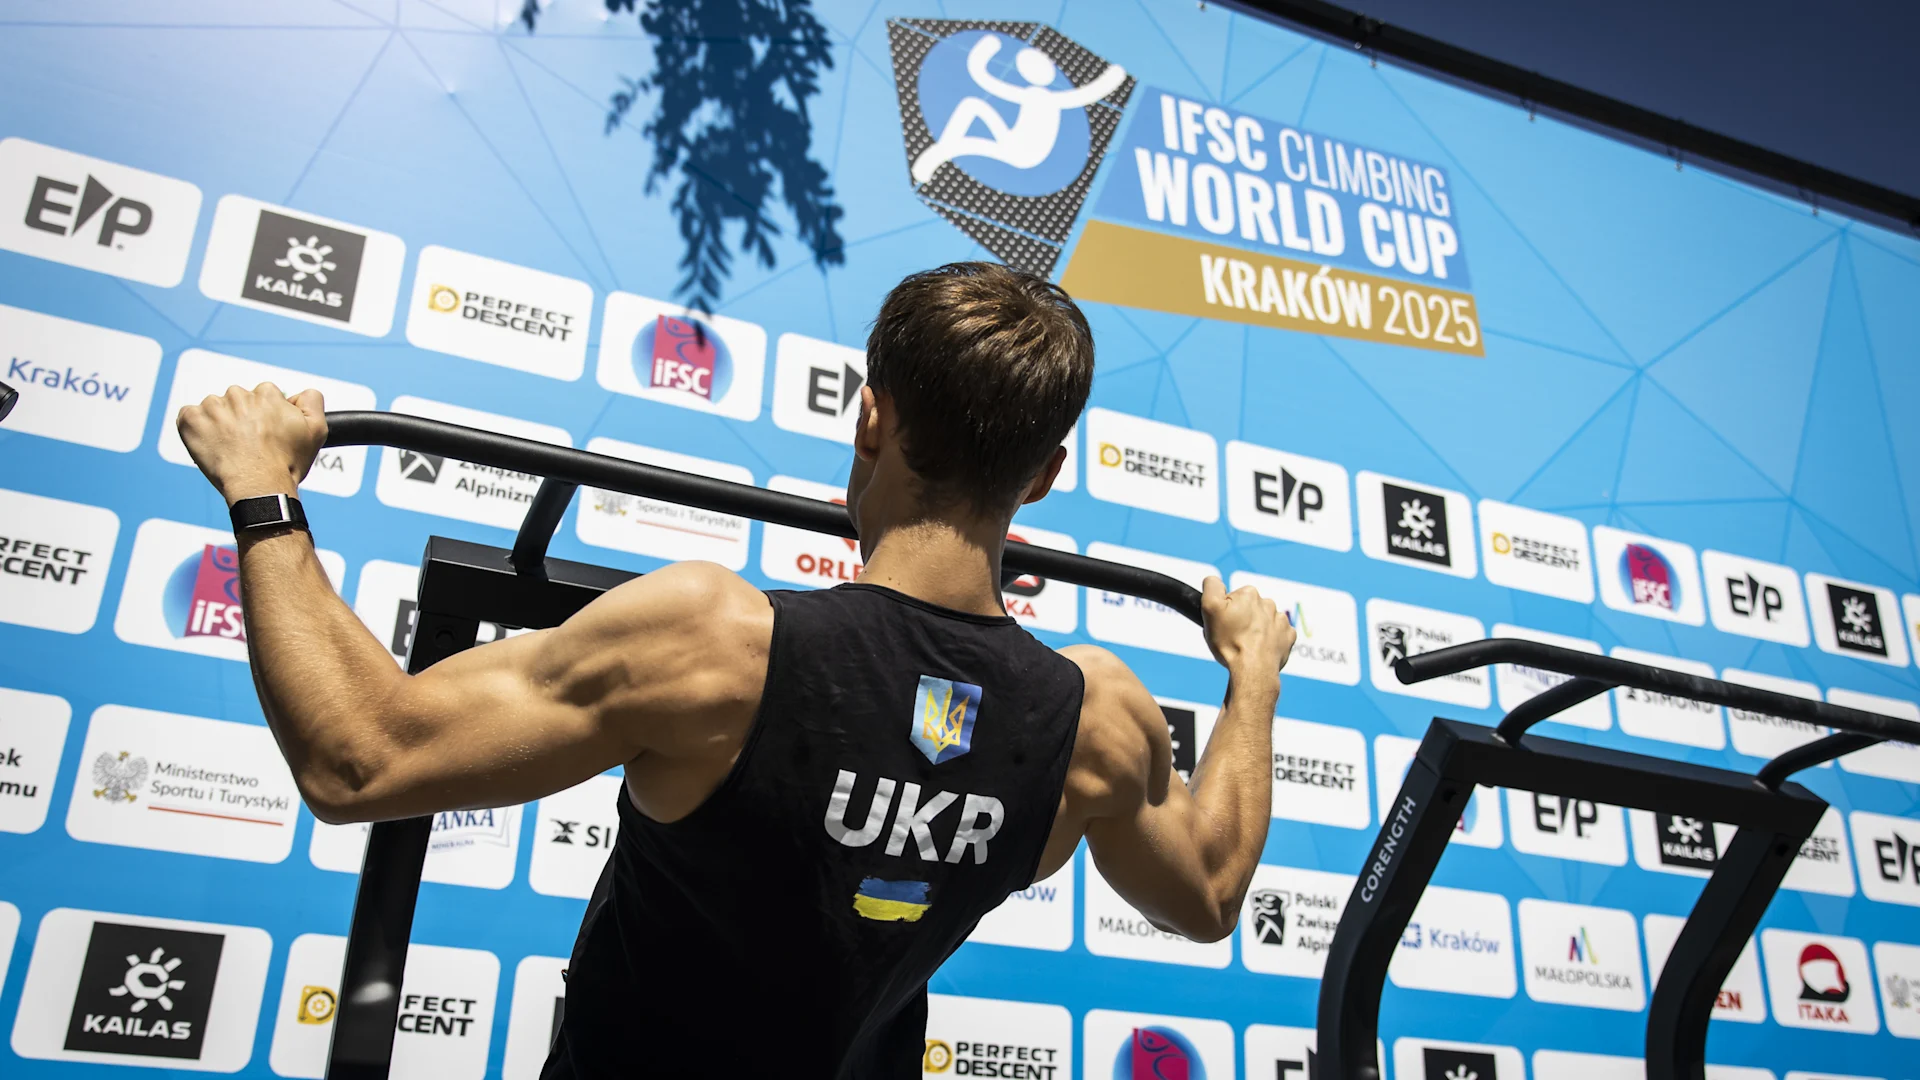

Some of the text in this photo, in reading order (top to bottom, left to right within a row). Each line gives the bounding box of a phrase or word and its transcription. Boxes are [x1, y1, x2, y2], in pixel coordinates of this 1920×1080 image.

[1160, 94, 1452, 218] IFSC CLIMBING
[1133, 147, 1459, 280] WORLD CUP
[255, 275, 344, 308] KAILAS
[1200, 253, 1479, 348] KRAKÓW 2025
[465, 291, 575, 327] PERFECT
[461, 304, 573, 342] DESCENT
[7, 357, 130, 402] Kraków
[1124, 448, 1206, 474] PERFECT
[1124, 459, 1206, 489] DESCENT
[1390, 533, 1446, 558] KAILAS
[1512, 535, 1580, 559] PERFECT
[1513, 546, 1580, 572] DESCENT
[191, 599, 247, 639] iFS
[1838, 630, 1884, 650] KAILAS
[154, 761, 260, 788] Ministerstwo
[1274, 753, 1354, 775] PERFECT
[1275, 767, 1356, 791] DESCENT
[150, 780, 205, 801] Sportu
[219, 790, 289, 811] Turystyki
[824, 769, 1005, 865] UKR
[1360, 796, 1417, 904] CORENGTH
[1662, 841, 1717, 863] KAILAS
[1295, 892, 1337, 909] Polski
[1429, 928, 1500, 955] Kraków
[1535, 965, 1633, 990] MAŁOPOLSKA
[403, 994, 478, 1015] FECT
[1797, 1003, 1850, 1024] ITAKA
[83, 1014, 192, 1040] KAILAS
[397, 1013, 475, 1037] CENT
[956, 1041, 1058, 1063] PERFECT
[955, 1057, 1058, 1080] DESCENT
